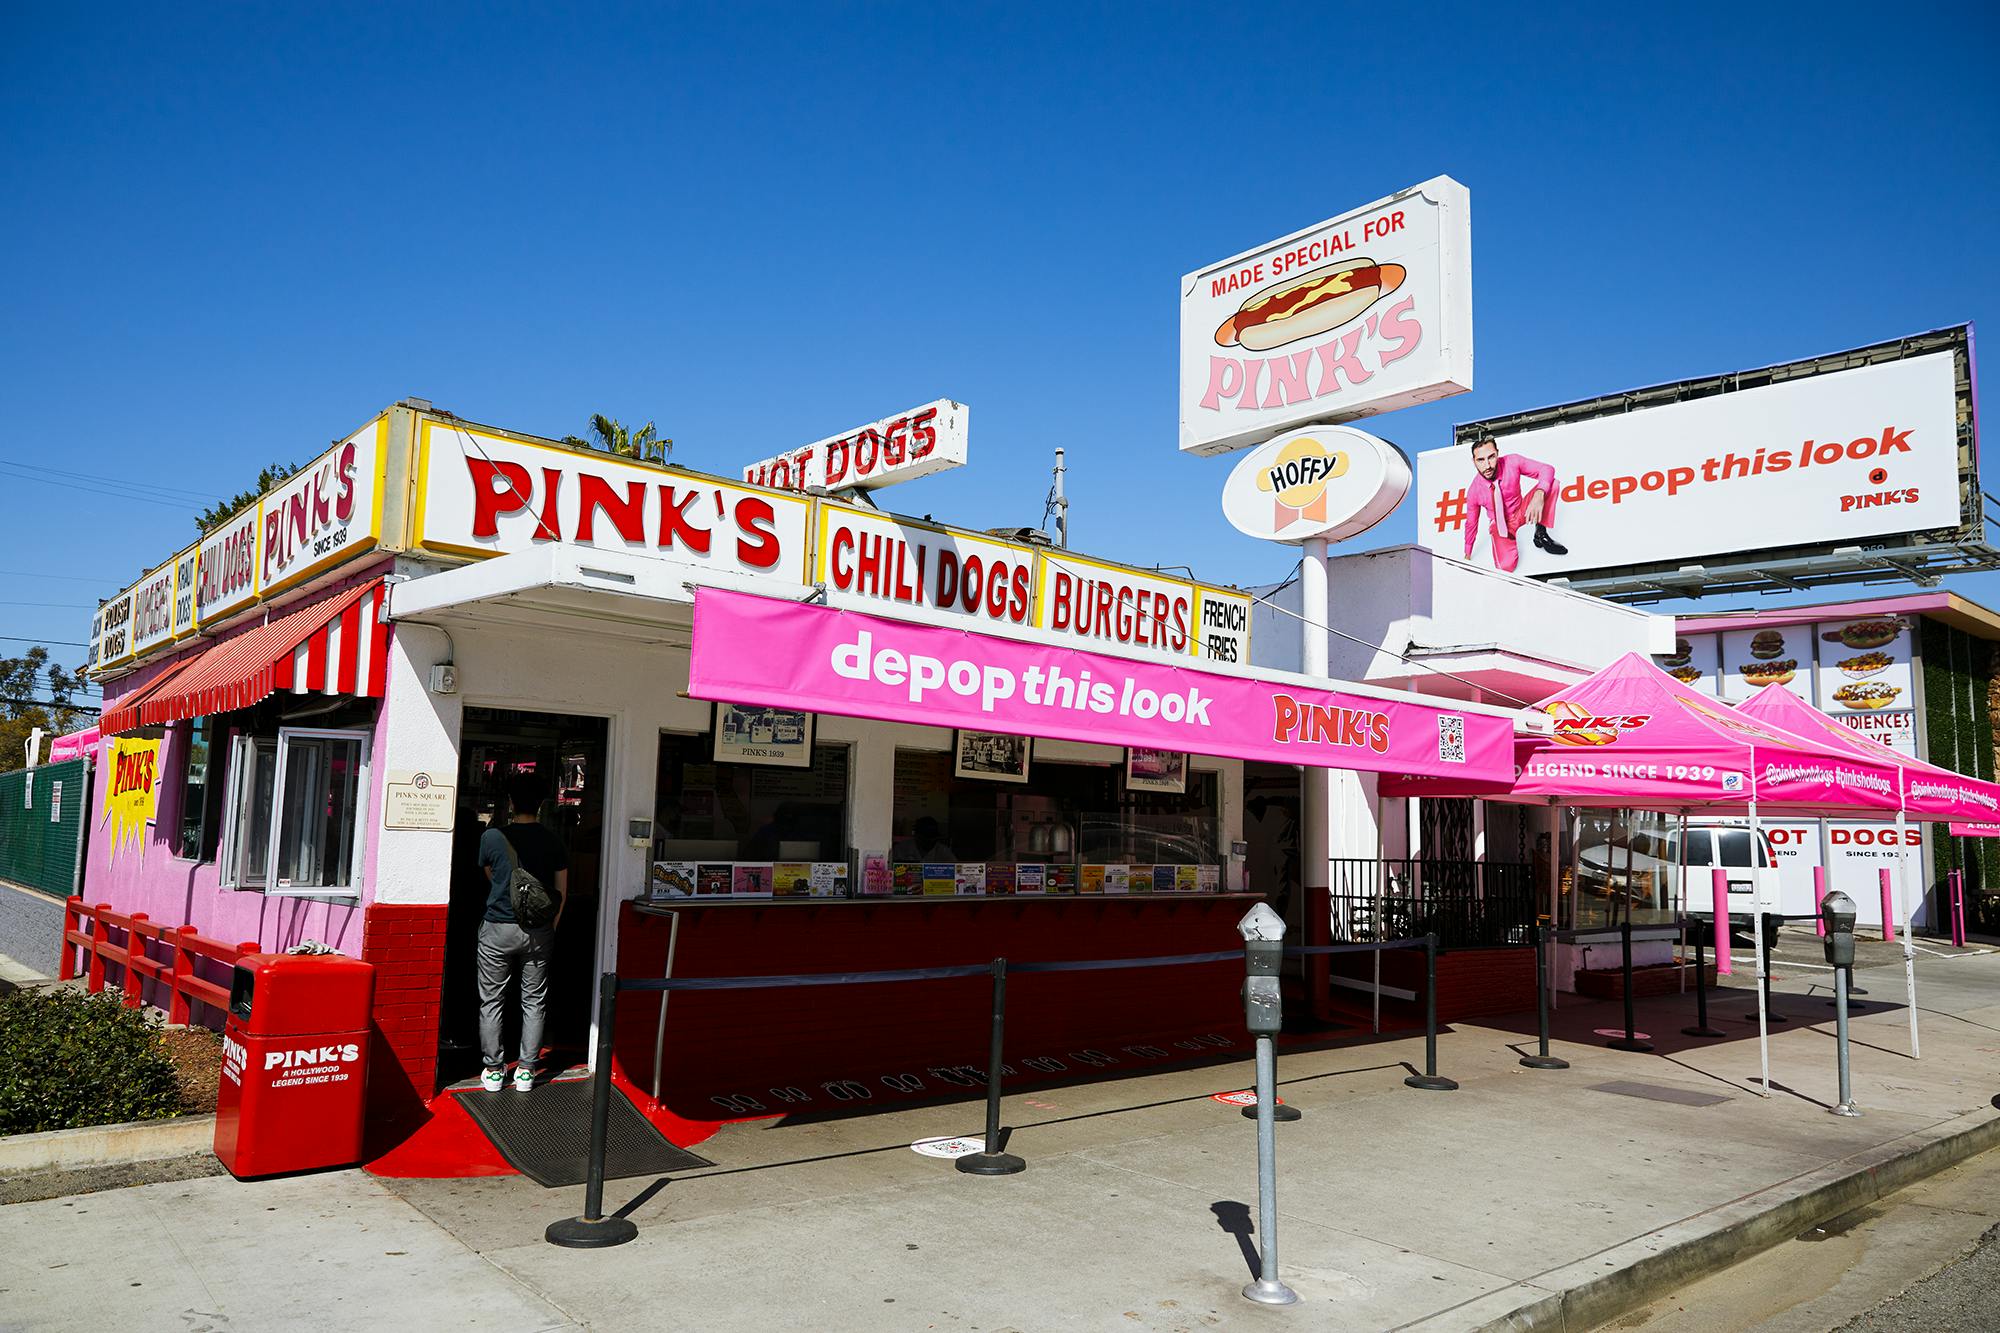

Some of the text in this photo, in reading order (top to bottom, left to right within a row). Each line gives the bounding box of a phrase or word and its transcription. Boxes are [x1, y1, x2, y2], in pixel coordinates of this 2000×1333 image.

[1211, 211, 1405, 298] MADE SPECIAL FOR
[1199, 294, 1422, 411] PINK'S
[826, 407, 938, 485] DOGS
[1270, 456, 1336, 493] HOFFY
[262, 442, 356, 582] PINK'S
[466, 455, 781, 569] PINK'S
[1840, 488, 1919, 512] PINK'S
[313, 535, 332, 557] SINCE
[831, 526, 1030, 623] CHILI DOGS
[104, 596, 130, 631] POLISH
[1052, 572, 1189, 652] BURGERS
[1203, 598, 1247, 632] FRENCH
[1207, 633, 1238, 664] FRIES
[1272, 694, 1390, 754] PINK'S
[1839, 713, 1910, 729] UDIENCES
[113, 749, 154, 797] PINK'S
[1527, 763, 1597, 778] LEGEND
[1602, 764, 1658, 780] SINCE
[1664, 765, 1716, 781] 1939
[395, 791, 418, 799] PINK'S
[1768, 829, 1922, 846] OT DOGS
[1846, 850, 1878, 858] SINCE
[222, 1034, 248, 1071] PINK'S
[264, 1044, 359, 1071] PINK'S
[271, 1074, 349, 1088] LEGEND SINCE 1939
[290, 1065, 340, 1077] HOLLYWOOD
